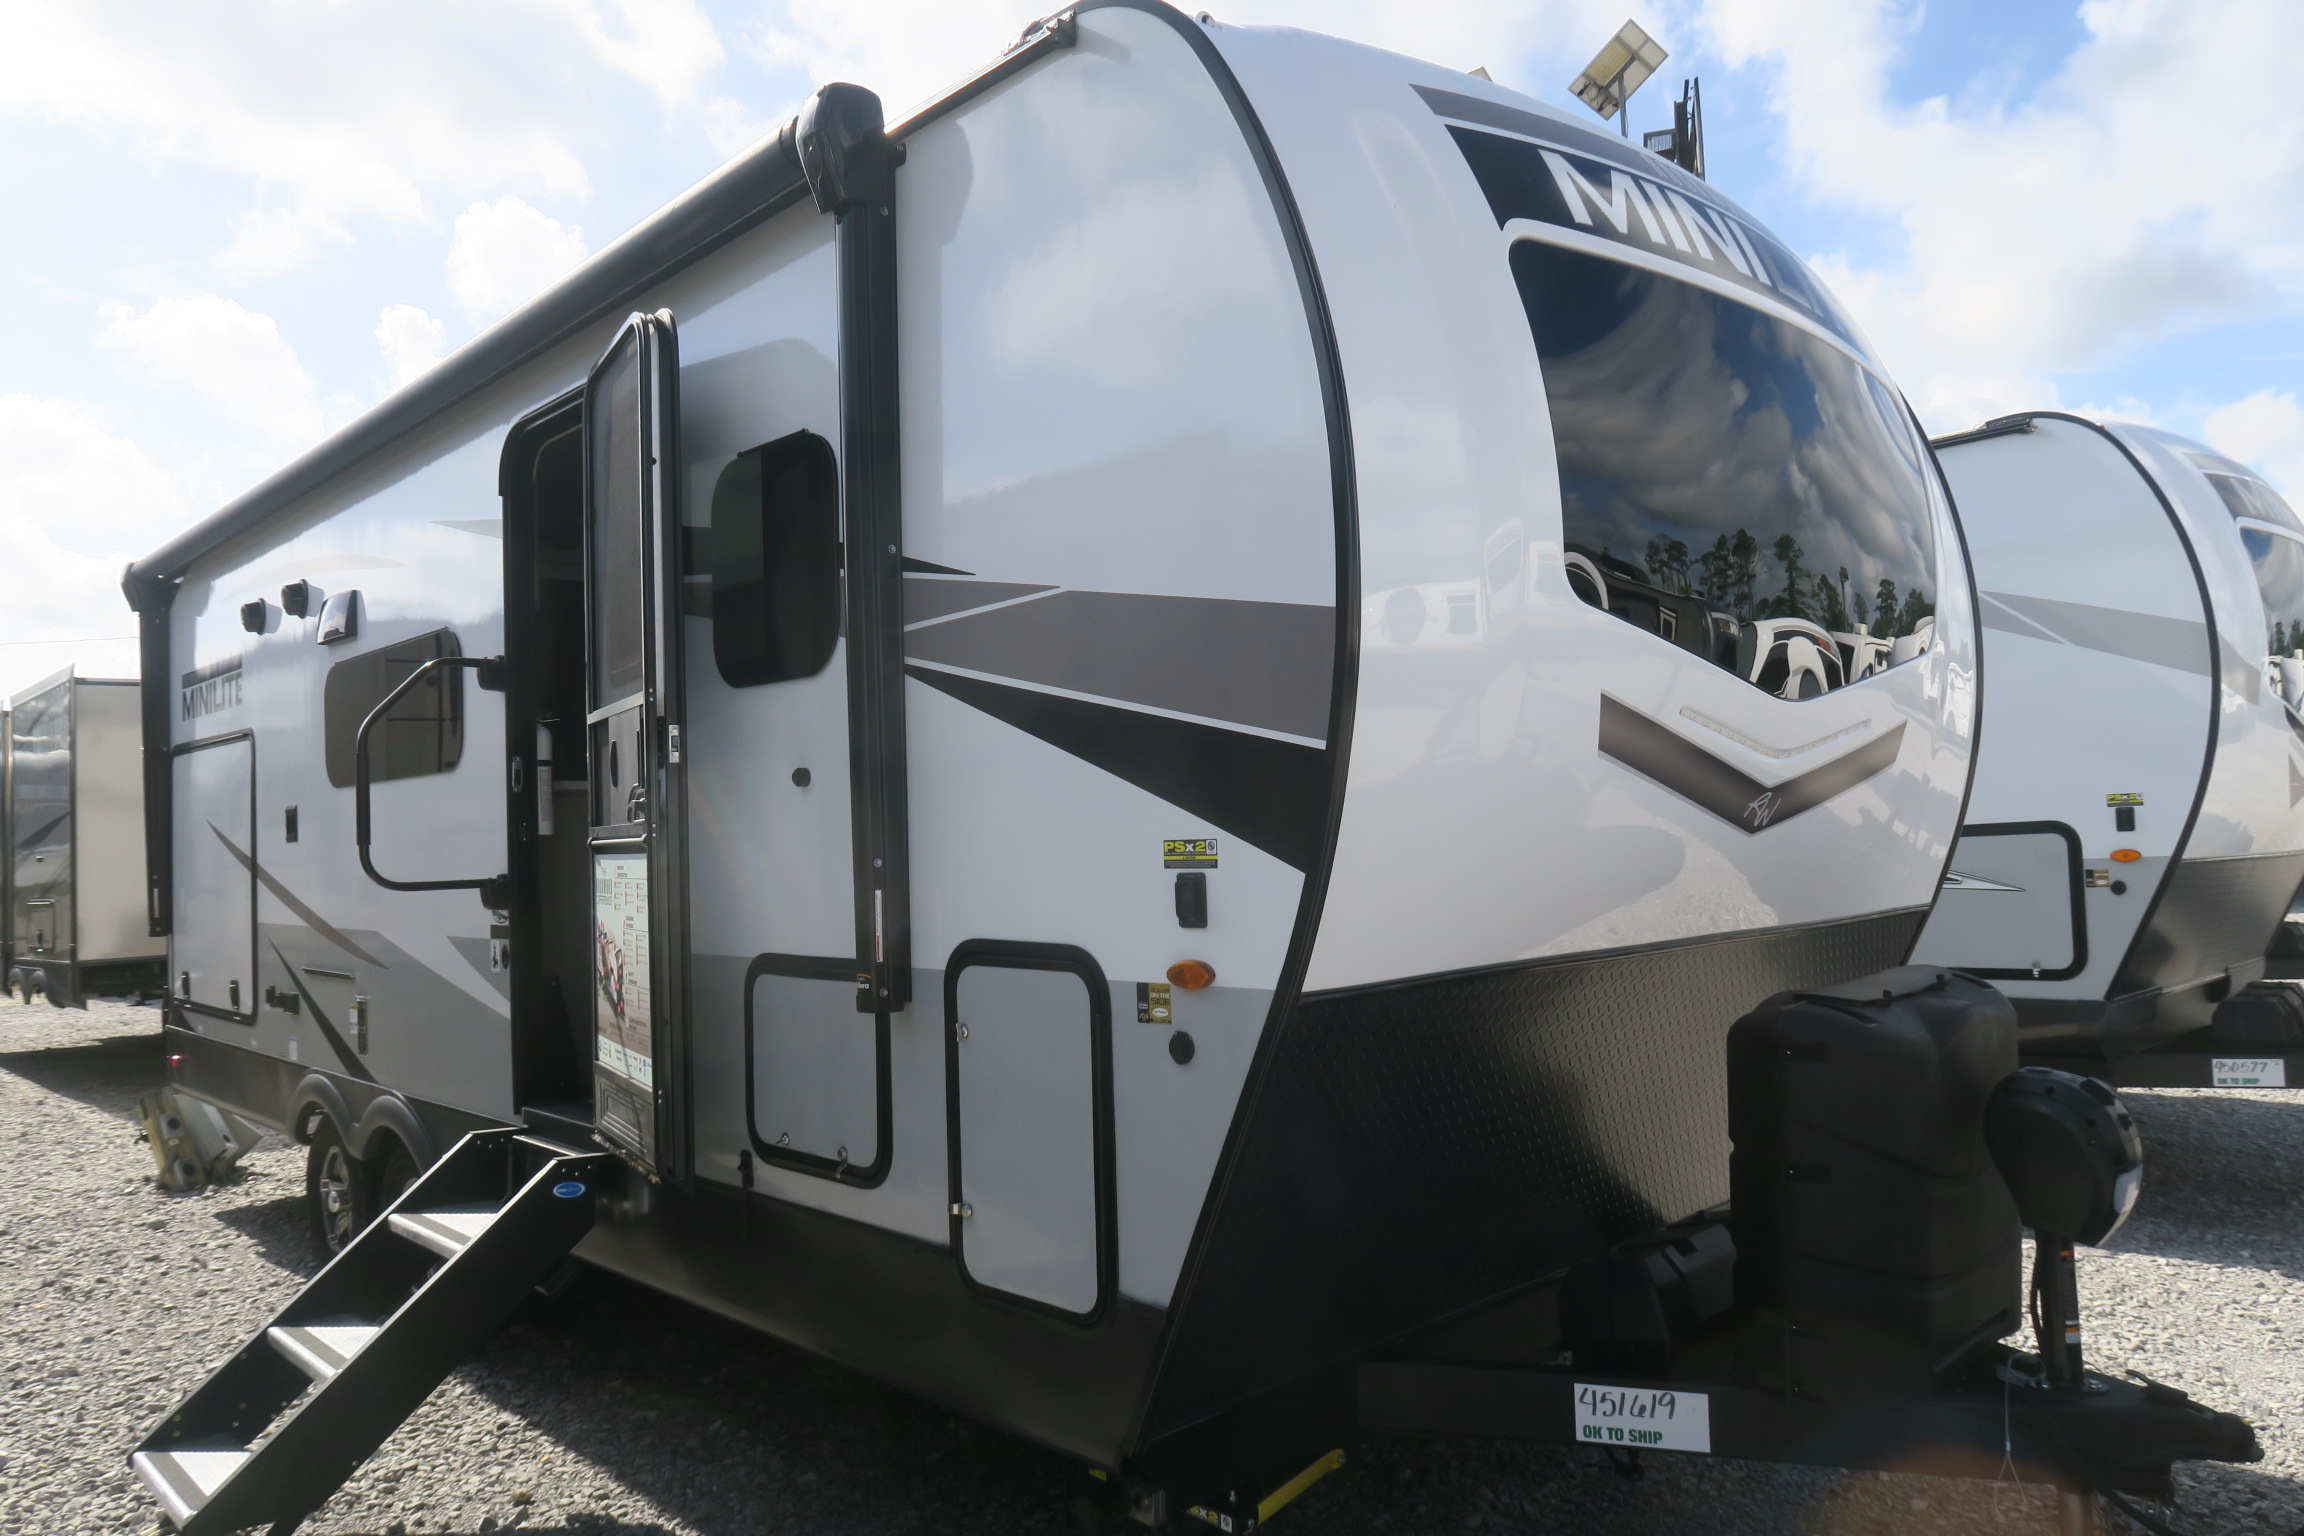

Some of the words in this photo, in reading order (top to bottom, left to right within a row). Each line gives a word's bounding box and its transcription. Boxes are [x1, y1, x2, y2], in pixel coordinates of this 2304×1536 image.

[1537, 149, 1772, 288] MINI
[182, 669, 242, 722] MINILITE
[1164, 841, 1206, 853] PSx2
[1579, 1387, 1676, 1420] 451619
[1583, 1425, 1602, 1439] OK
[1607, 1427, 1624, 1441] TO
[1628, 1429, 1663, 1444] SHIP
